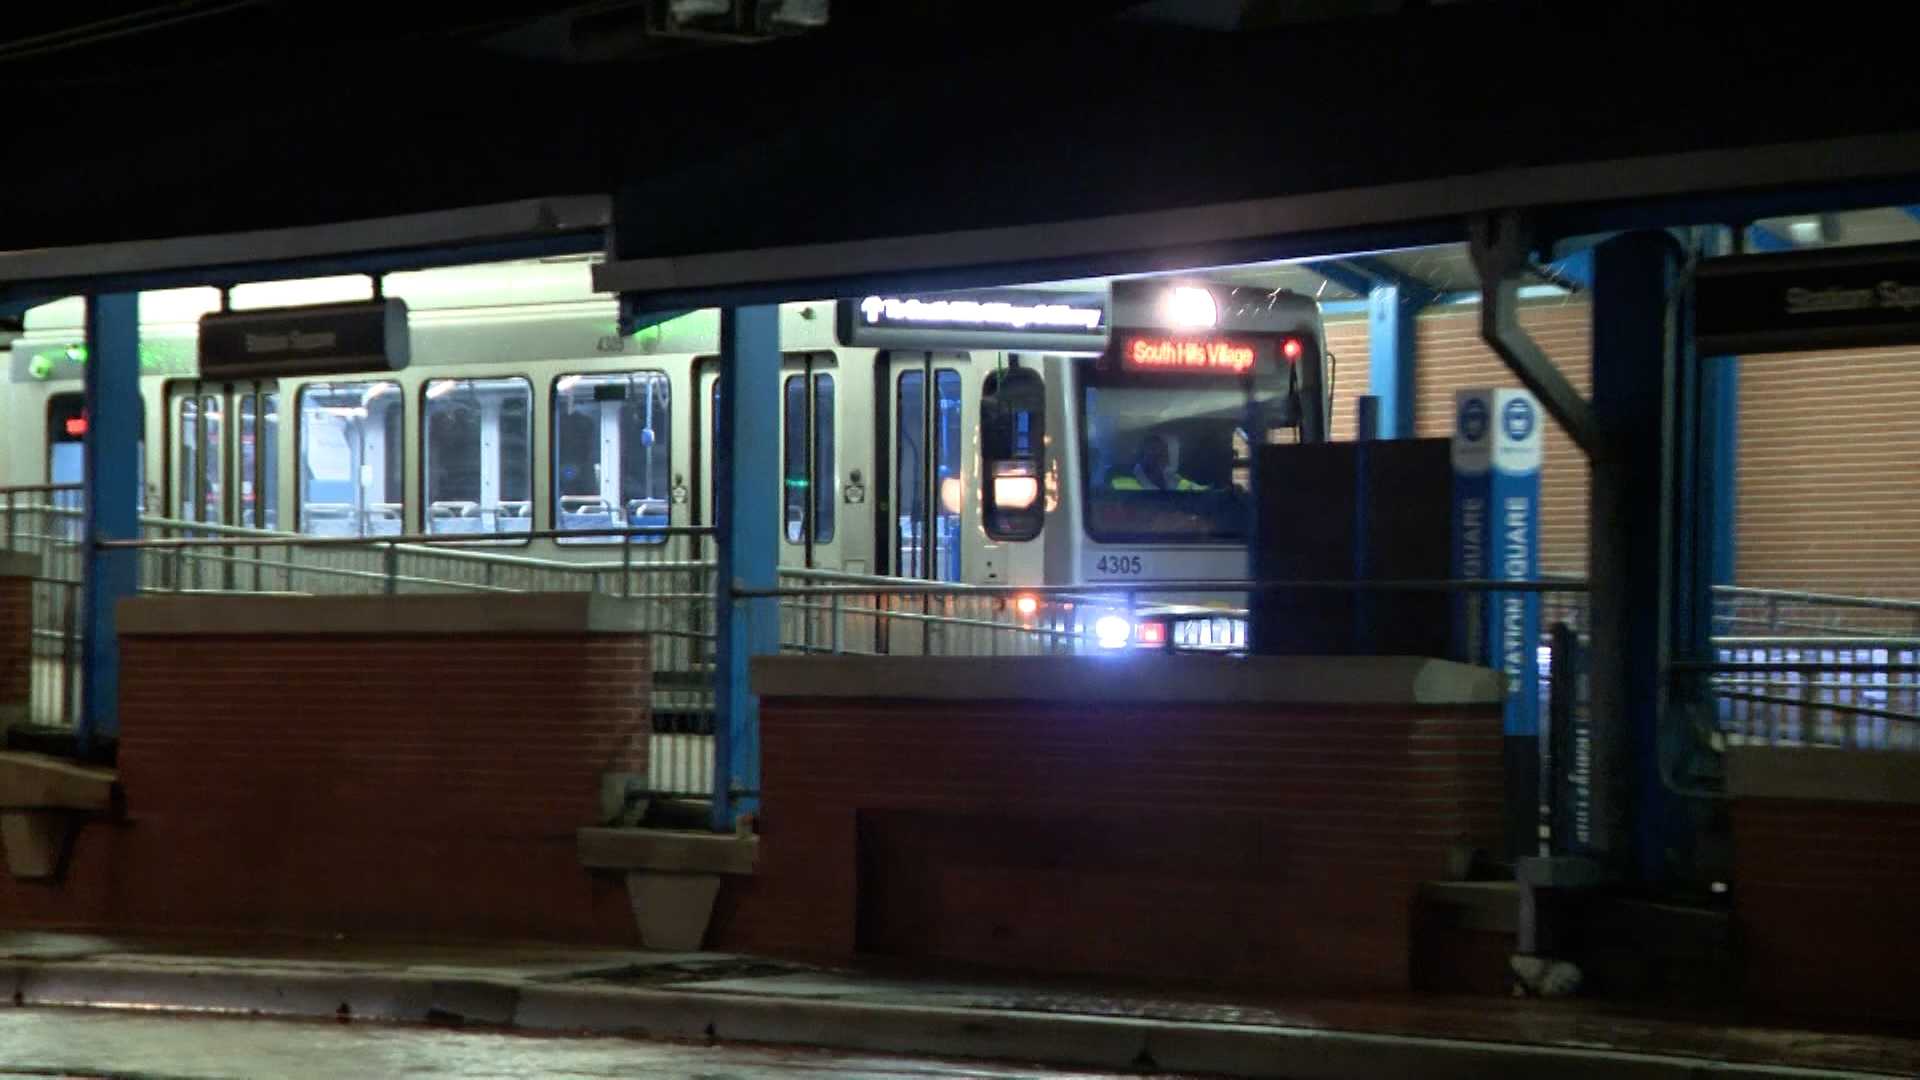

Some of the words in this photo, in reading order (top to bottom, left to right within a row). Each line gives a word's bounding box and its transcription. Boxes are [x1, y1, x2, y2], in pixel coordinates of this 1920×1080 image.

[1133, 342, 1176, 363] South
[1207, 343, 1254, 371] Village
[1096, 555, 1141, 575] 4305
[1463, 496, 1481, 583] QUARE
[1503, 496, 1528, 583] QUARE
